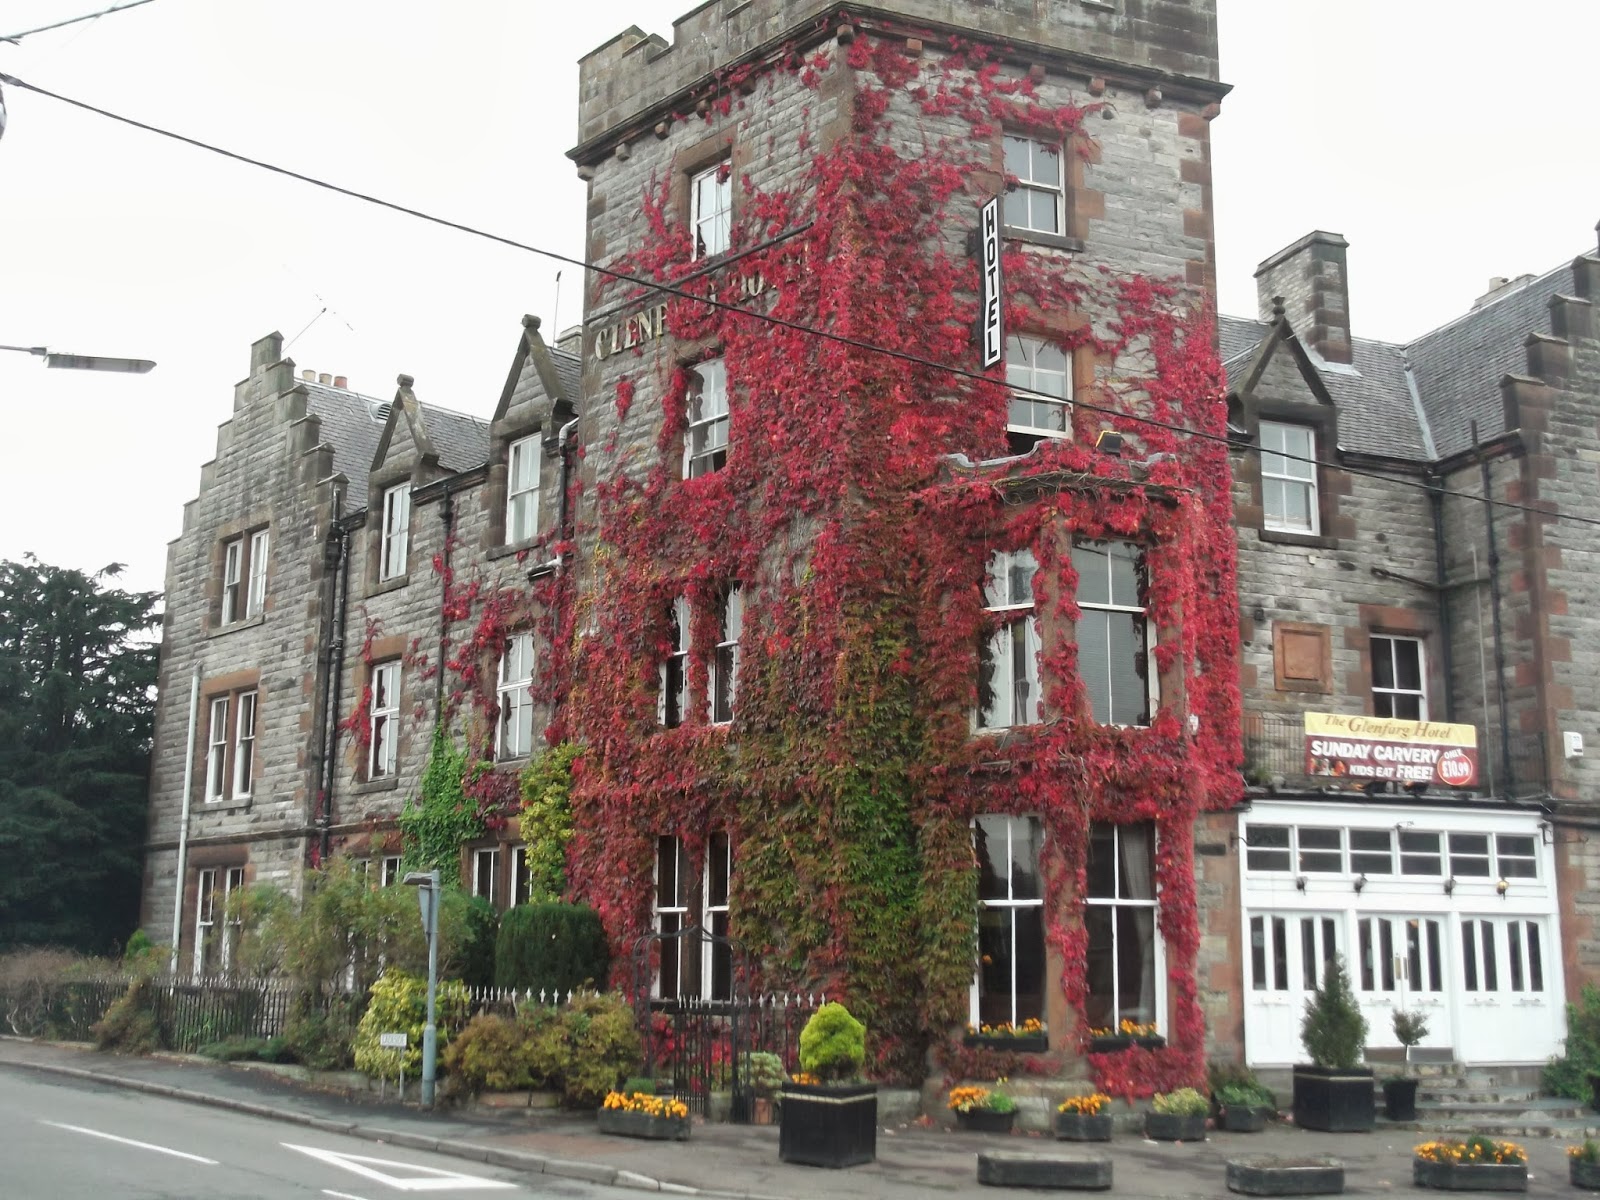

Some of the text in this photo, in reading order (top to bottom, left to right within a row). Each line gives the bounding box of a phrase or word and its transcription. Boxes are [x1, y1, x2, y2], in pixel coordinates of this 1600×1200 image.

[984, 204, 998, 361] HOTEL
[1324, 714, 1451, 738] The Glenfarg Hotel
[1310, 740, 1440, 764] SUNDAY CARVERY
[1443, 748, 1462, 760] ONLY
[1349, 764, 1434, 780] KIDS EAT FREE!
